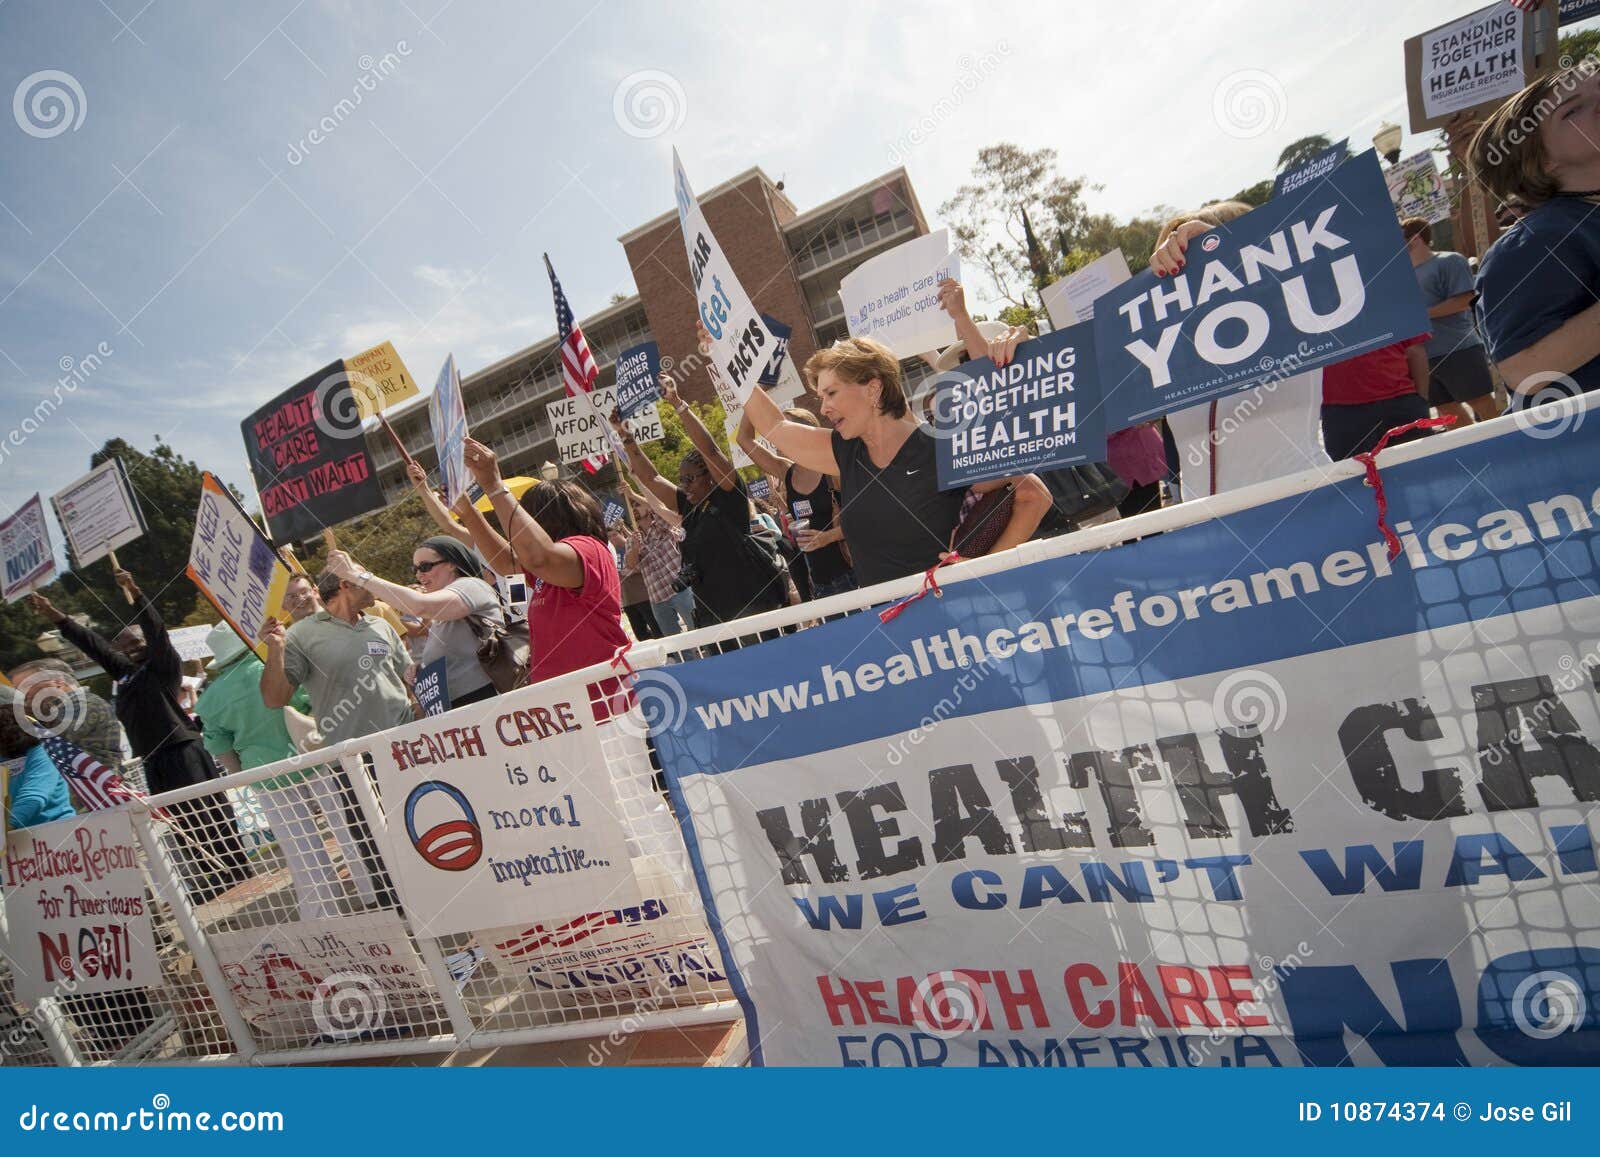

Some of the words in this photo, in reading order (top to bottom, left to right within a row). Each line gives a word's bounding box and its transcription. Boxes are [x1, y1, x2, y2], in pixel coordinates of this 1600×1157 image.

[1431, 10, 1517, 56] STANDING
[1431, 28, 1516, 69] TOGETHER
[1430, 48, 1517, 92] HEALTH
[1431, 81, 1476, 101] INSURANCE
[1478, 67, 1517, 87] REFORM
[1283, 151, 1337, 187] STANDING
[691, 231, 712, 291] EAR
[1118, 203, 1351, 334] THANK
[700, 272, 732, 341] Get
[884, 285, 910, 305] health
[912, 275, 934, 292] care
[886, 304, 912, 327] public
[914, 294, 939, 312] optio
[1124, 253, 1366, 390] YOU
[726, 317, 766, 388] FACTS
[951, 347, 1076, 403] STANDING
[549, 401, 576, 418] WE
[617, 373, 654, 407] HEALTH
[951, 372, 1075, 424] TOGETHER
[272, 427, 319, 471] CARE
[951, 402, 1076, 456] HEALTH
[952, 445, 1016, 469] INSURANCE
[1019, 432, 1076, 455] REFORM
[308, 451, 368, 496] WAIT
[198, 493, 220, 552] NEED
[193, 546, 211, 585] WE
[216, 594, 233, 615] A
[391, 725, 488, 772] HEALTH
[495, 702, 582, 747] CARE
[504, 763, 529, 785] is
[538, 765, 556, 783] a
[488, 794, 581, 830] moral
[756, 724, 1298, 886] HEALTH
[6, 838, 84, 887] Healthcare
[75, 827, 139, 882] Reform
[37, 889, 65, 920] for
[63, 884, 145, 918] Americans
[793, 883, 928, 931] WE
[951, 854, 1253, 911] CAN'T
[38, 921, 133, 982] NOW!
[816, 967, 1051, 1031] HEALTH
[1063, 961, 1271, 1030] CARE
